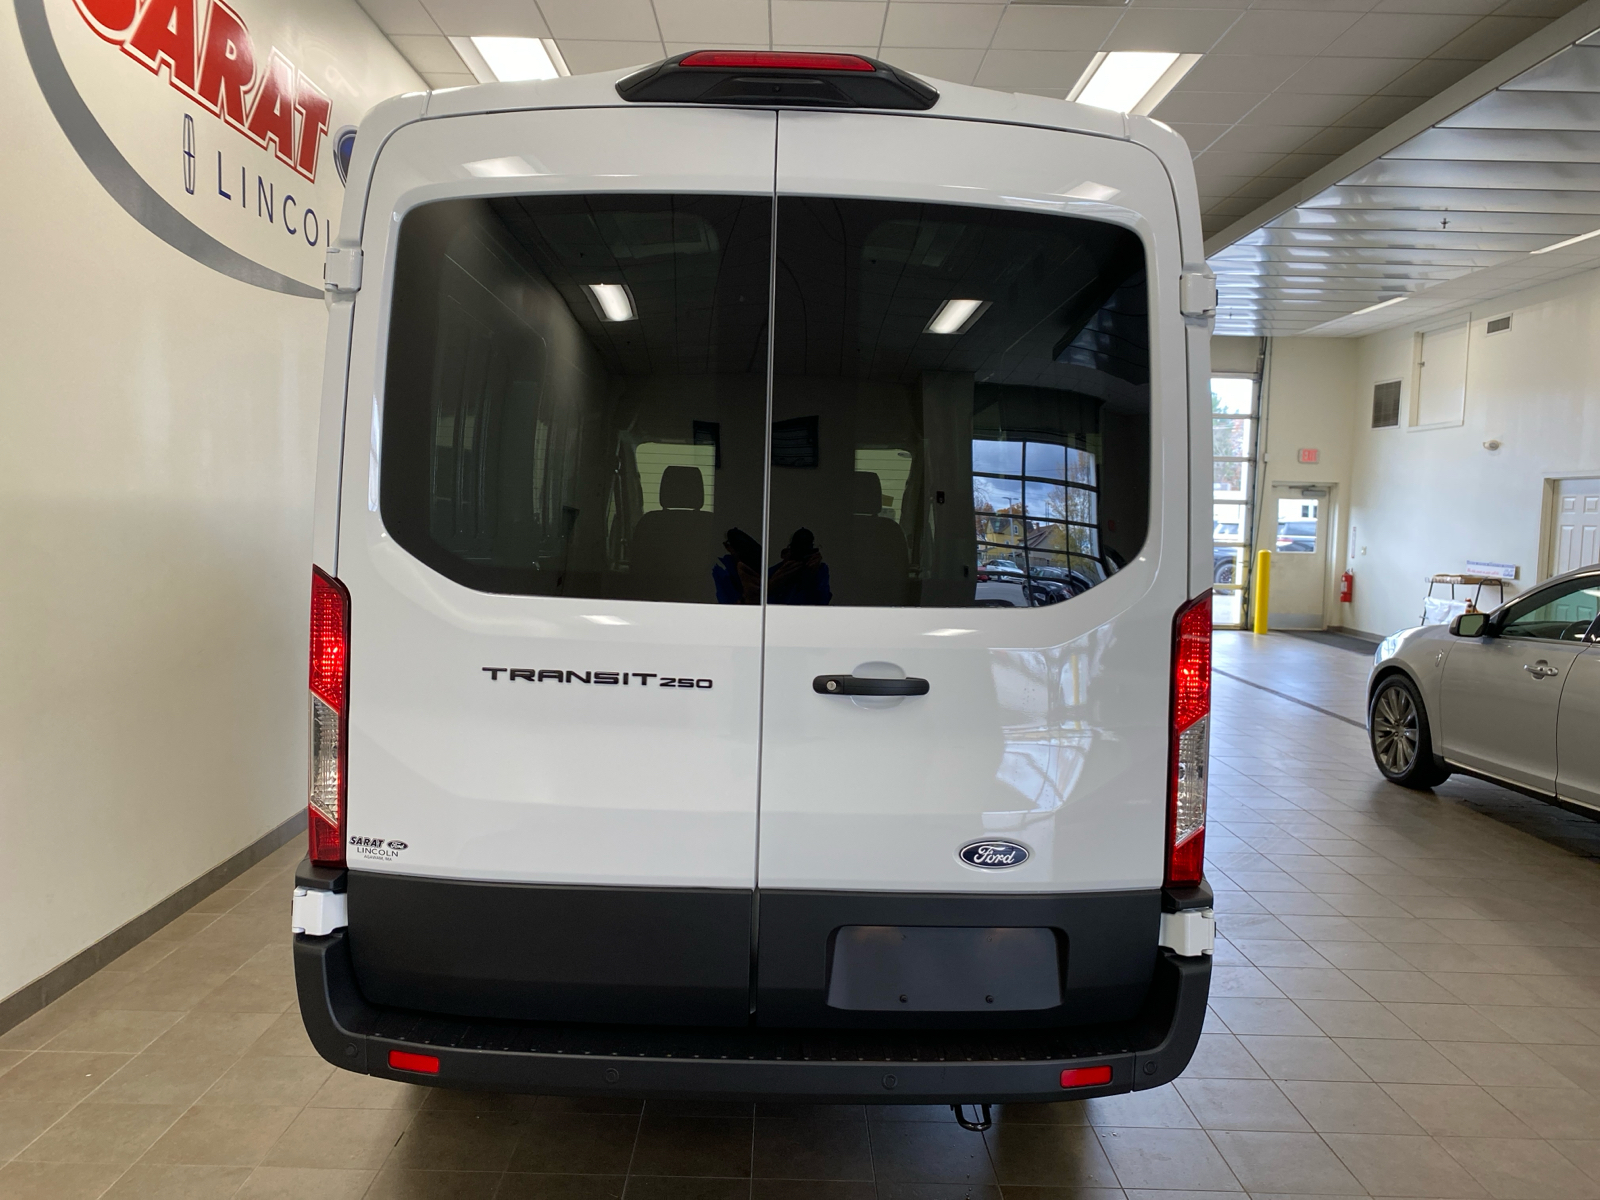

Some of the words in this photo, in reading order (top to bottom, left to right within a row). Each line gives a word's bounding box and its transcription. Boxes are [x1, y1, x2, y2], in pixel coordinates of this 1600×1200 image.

[1302, 449, 1318, 462] EXIT
[482, 667, 657, 686] TRANSIT
[659, 677, 713, 689] 250
[349, 836, 385, 848] SARAT
[357, 847, 399, 857] LINCOLN
[973, 846, 1016, 863] Ford
